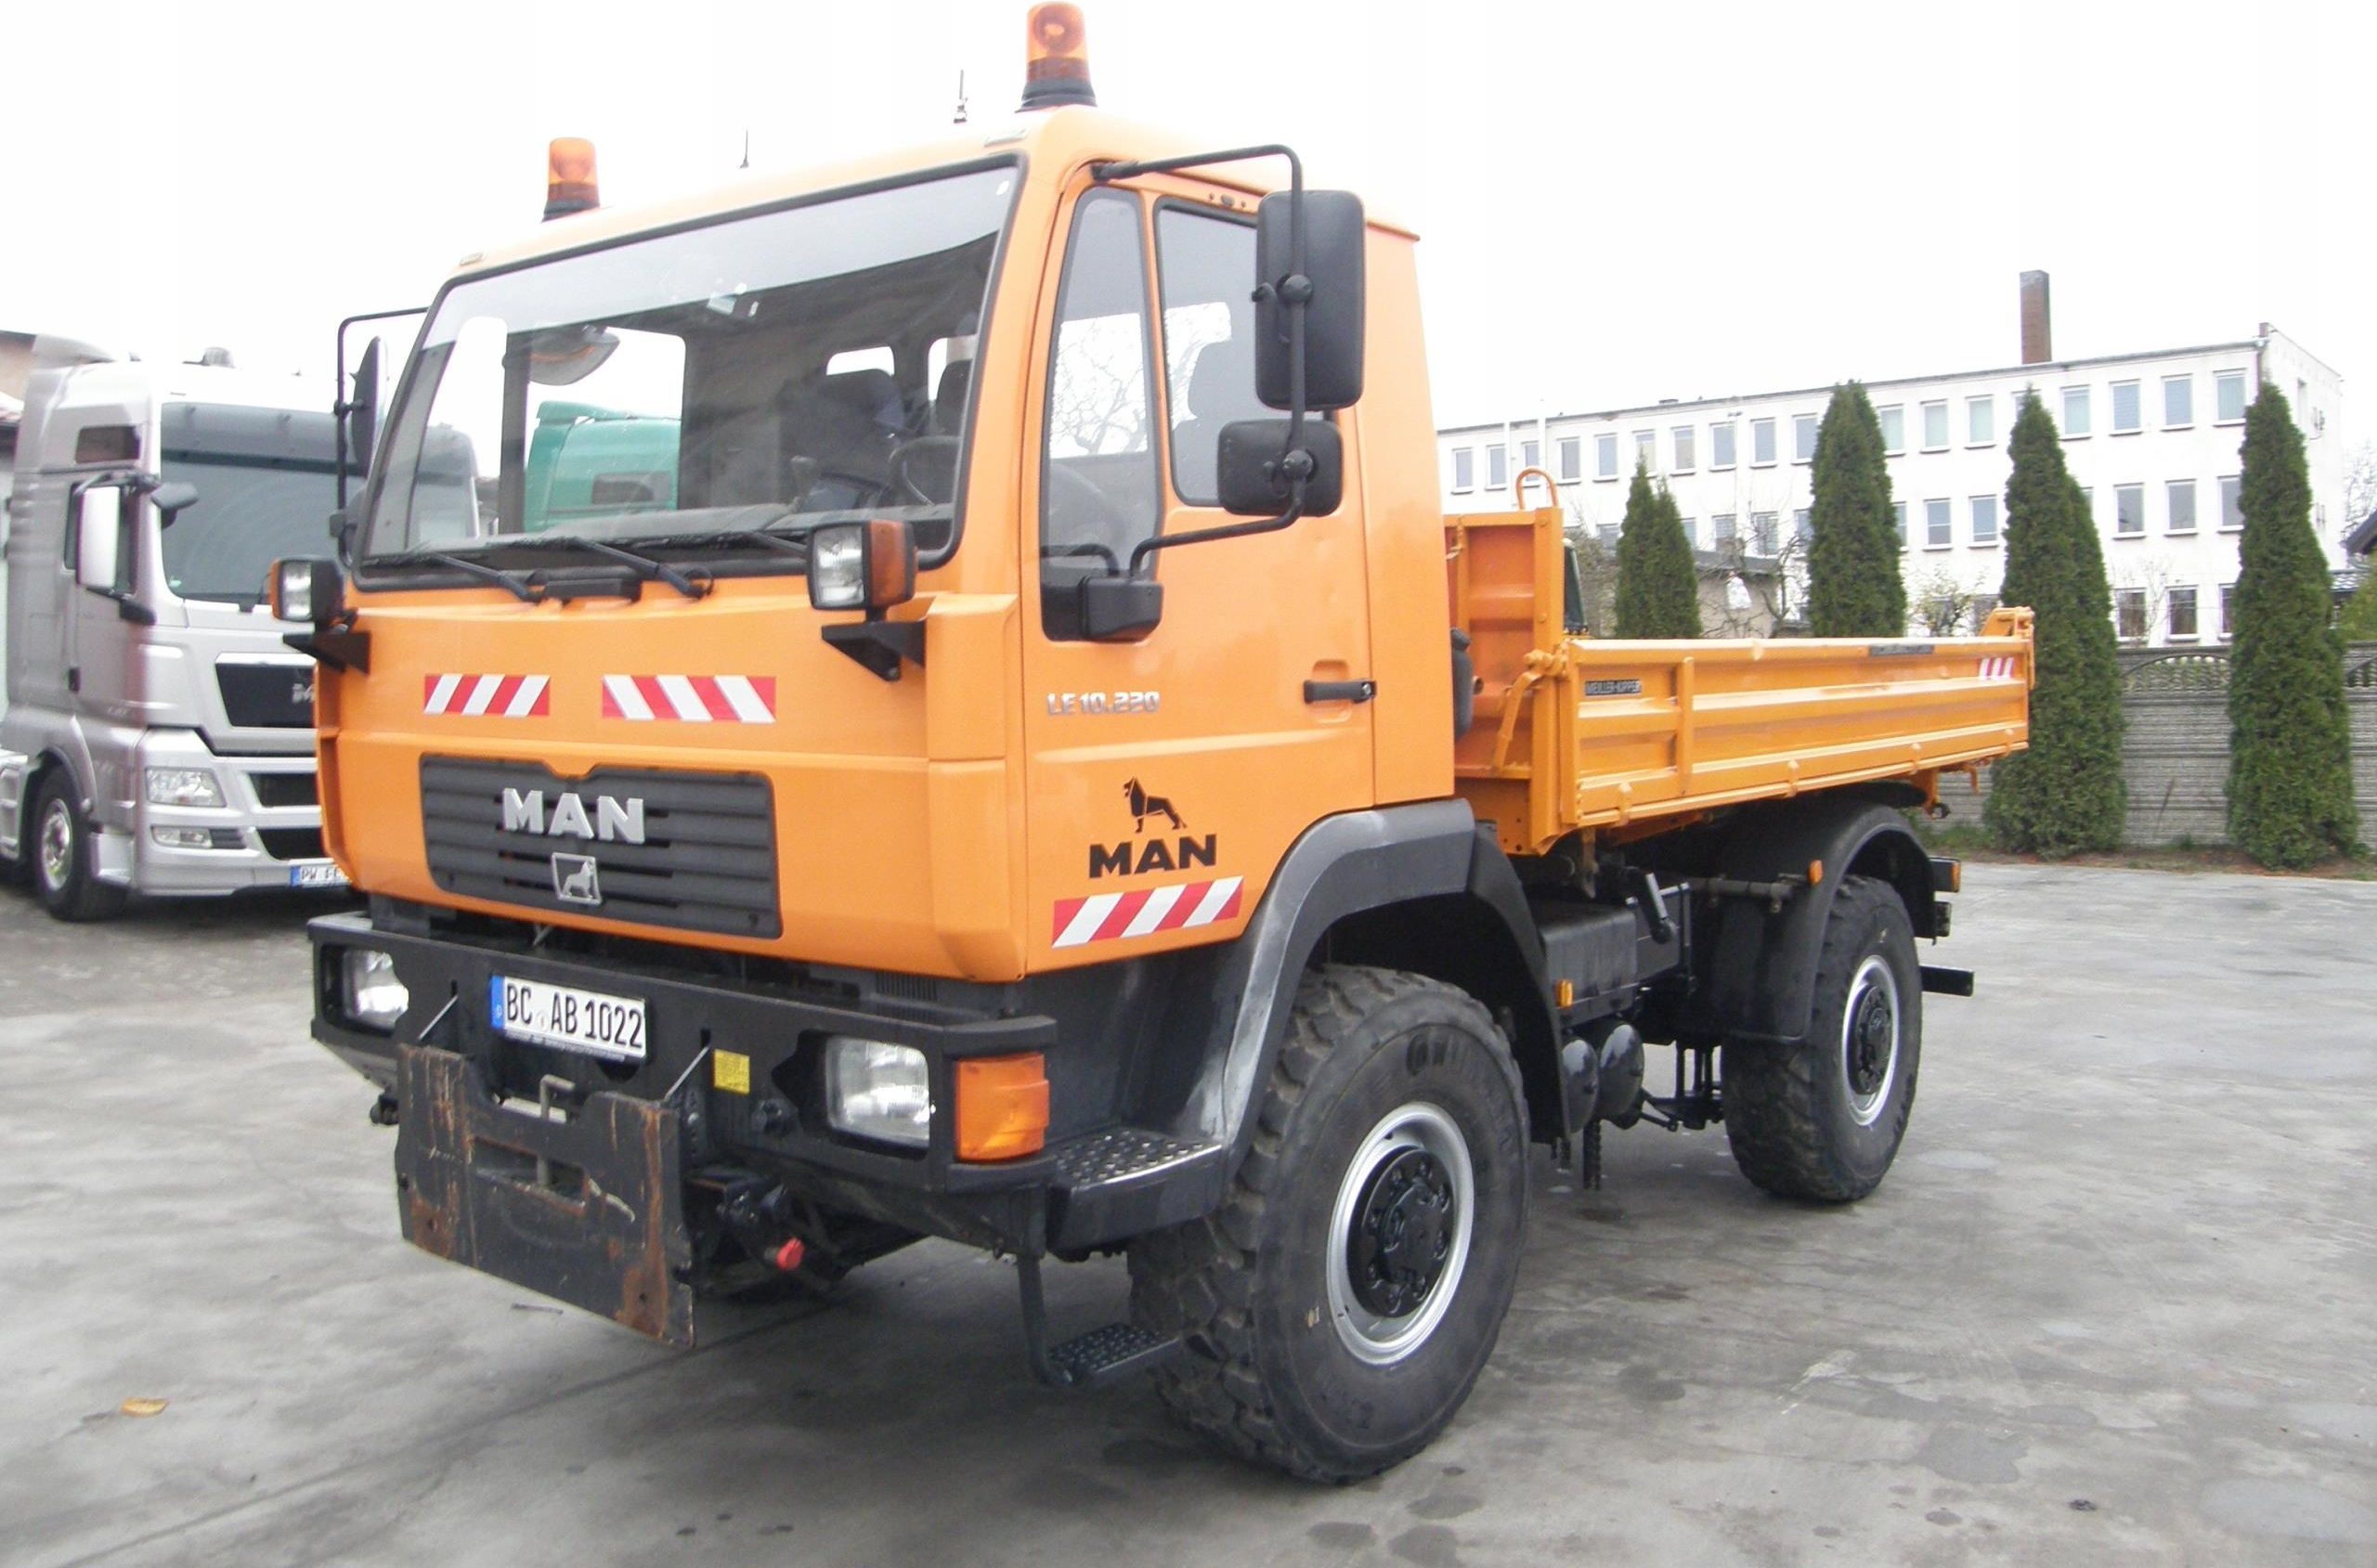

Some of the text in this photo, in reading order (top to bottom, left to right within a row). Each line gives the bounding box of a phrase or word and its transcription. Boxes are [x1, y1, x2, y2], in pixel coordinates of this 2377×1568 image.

[502, 787, 644, 844] MAN
[1089, 834, 1217, 878] MAN
[506, 983, 532, 1025] BC
[551, 991, 578, 1033] AB
[585, 998, 643, 1048] 1022
